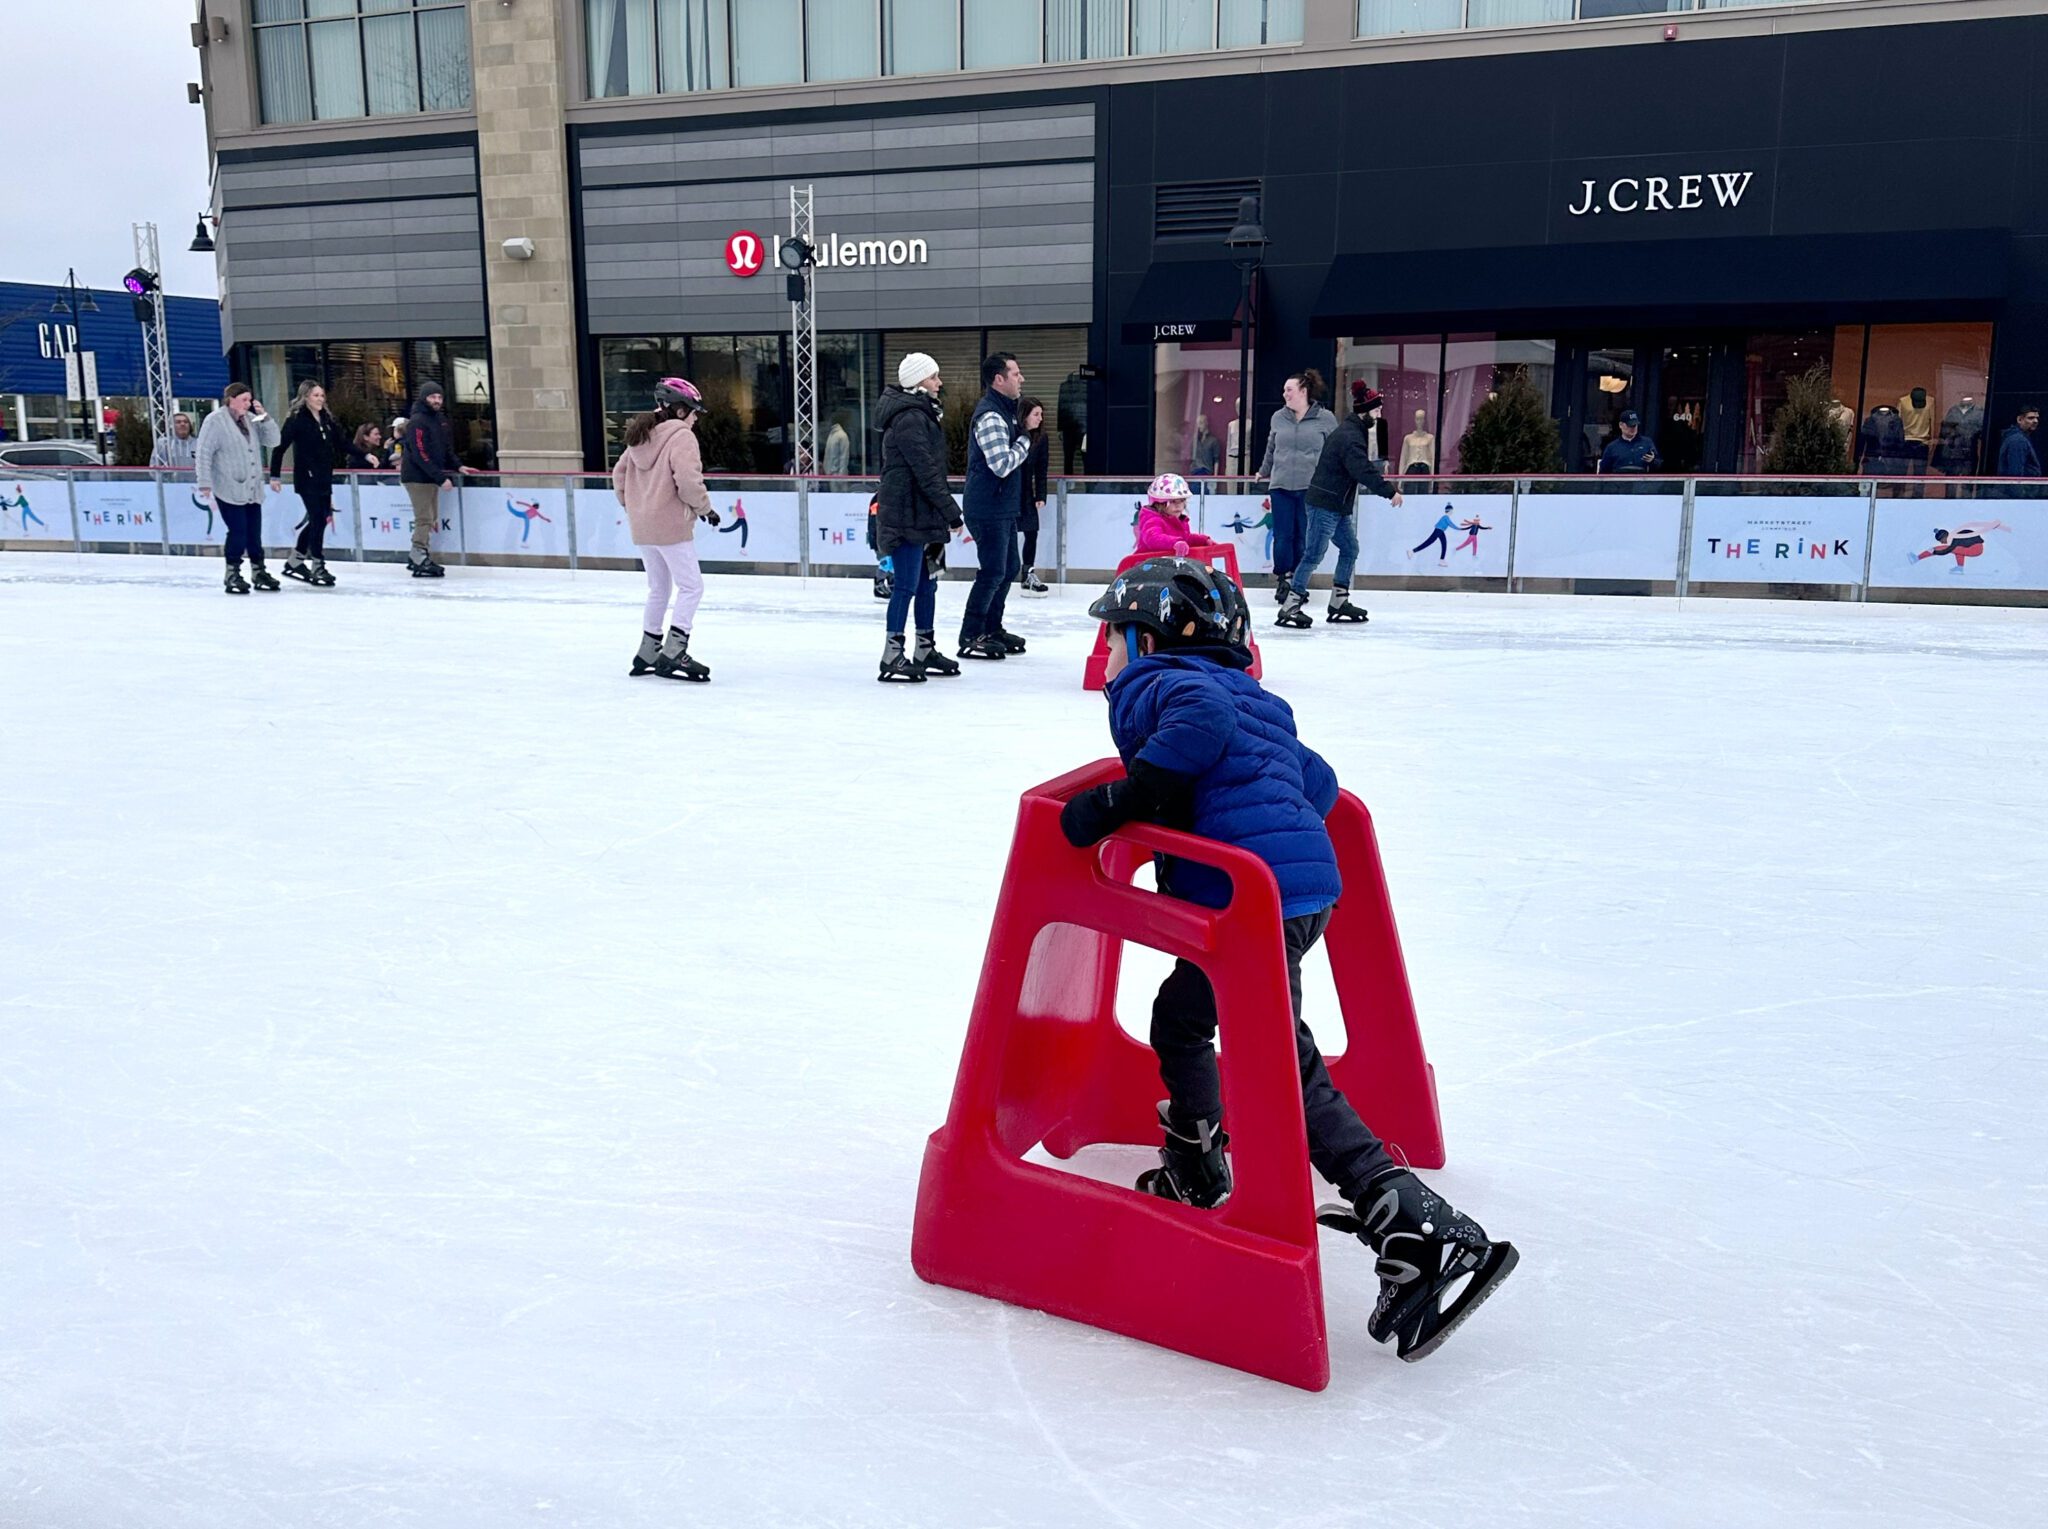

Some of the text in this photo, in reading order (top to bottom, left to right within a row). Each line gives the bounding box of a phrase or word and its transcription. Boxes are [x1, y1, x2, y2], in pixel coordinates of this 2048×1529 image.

[1568, 172, 1753, 215] J.CREW
[773, 232, 927, 268] lulemon
[39, 322, 77, 359] GAP
[1153, 324, 1196, 340] J.CREW
[1673, 412, 1692, 421] 640
[83, 510, 110, 526] THE
[369, 517, 401, 533] THE
[819, 527, 855, 545] THE
[1707, 538, 1761, 559] THE
